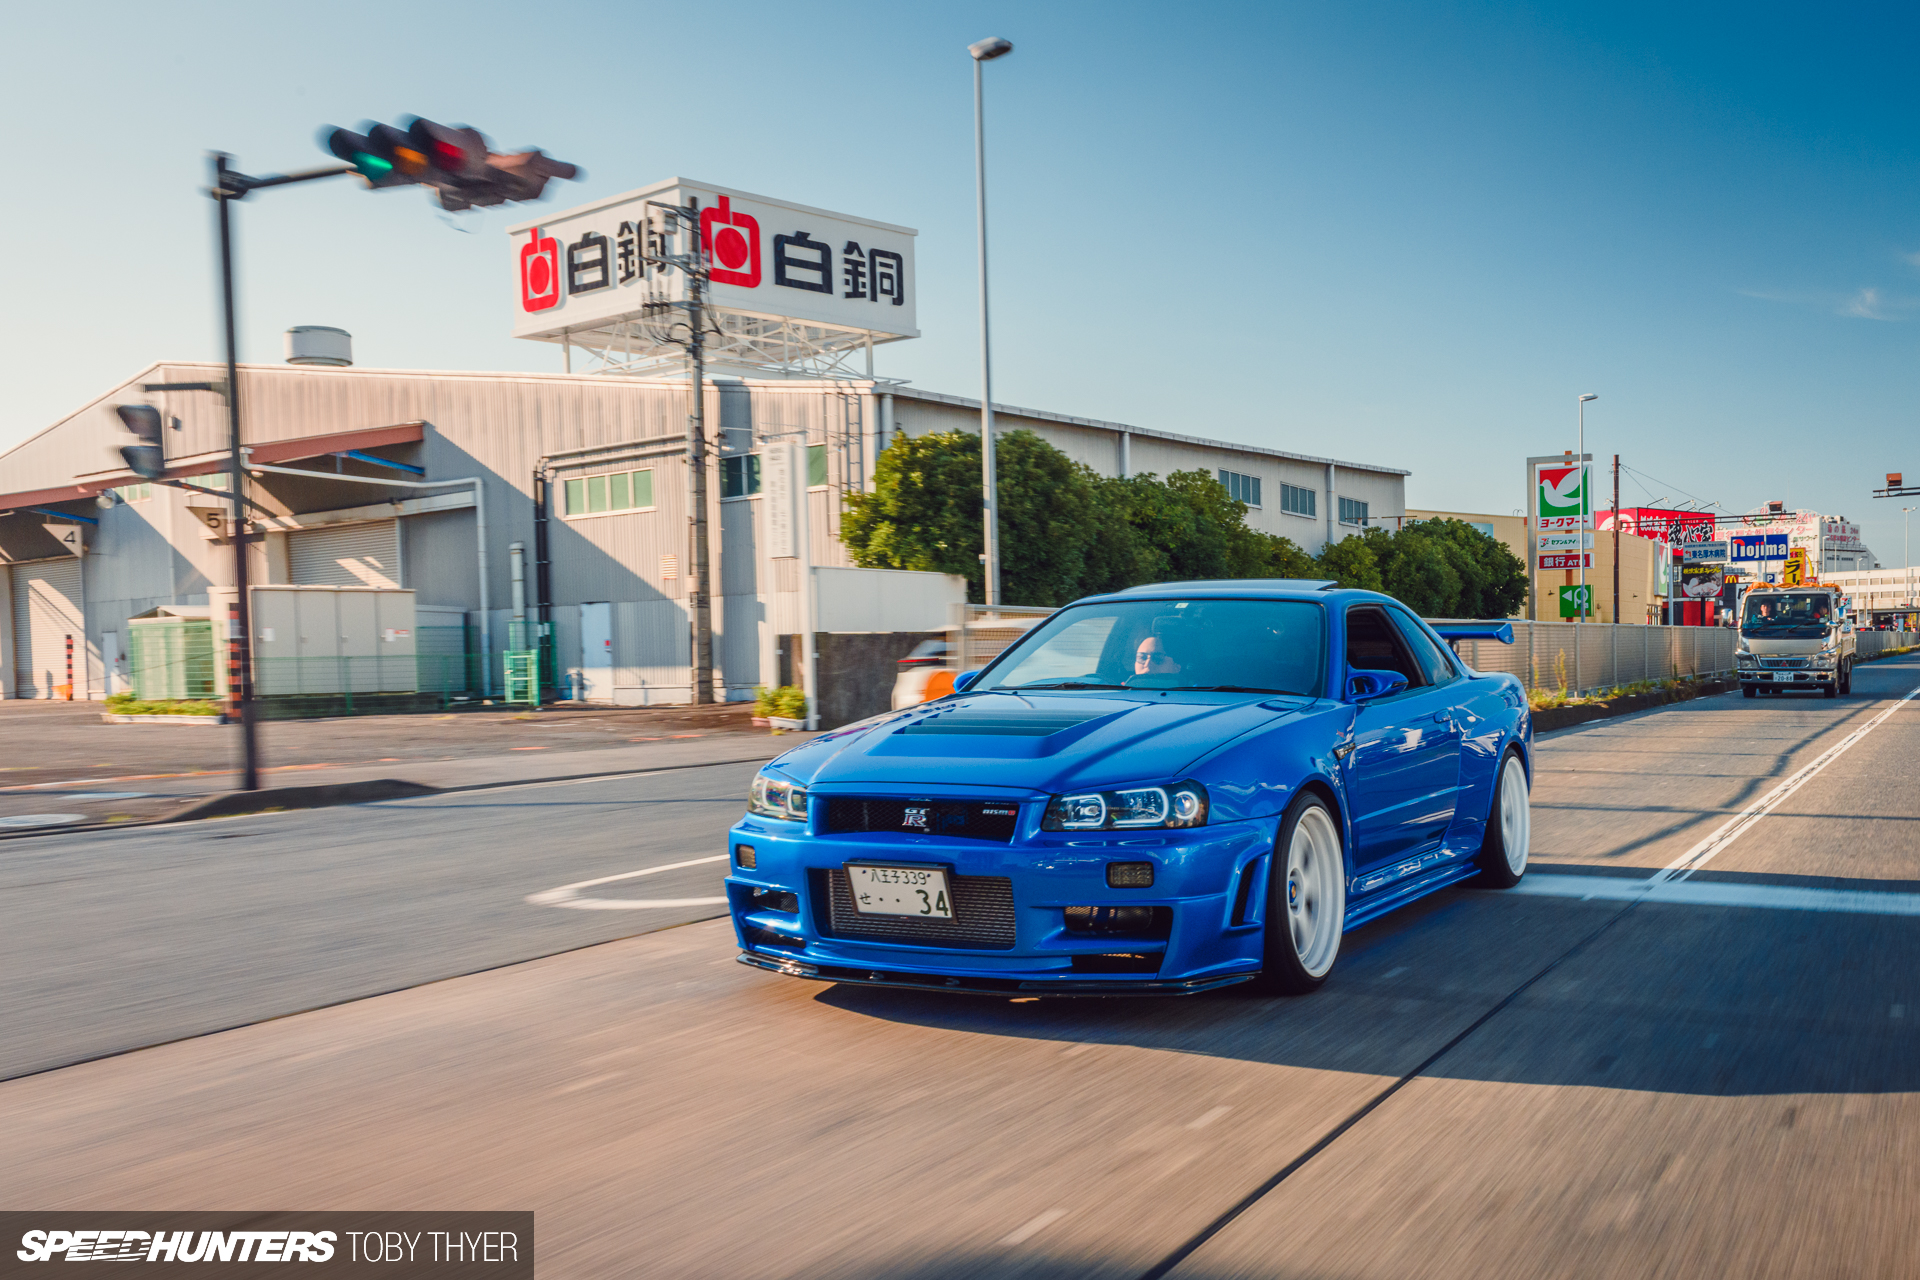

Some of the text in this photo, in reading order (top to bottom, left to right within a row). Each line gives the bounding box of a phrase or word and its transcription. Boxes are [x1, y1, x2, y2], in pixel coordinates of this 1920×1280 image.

[773, 230, 904, 307] 白銅
[206, 513, 221, 528] 5
[63, 531, 76, 544] 4
[1543, 556, 1566, 567] 銀行
[858, 892, 872, 905] せ
